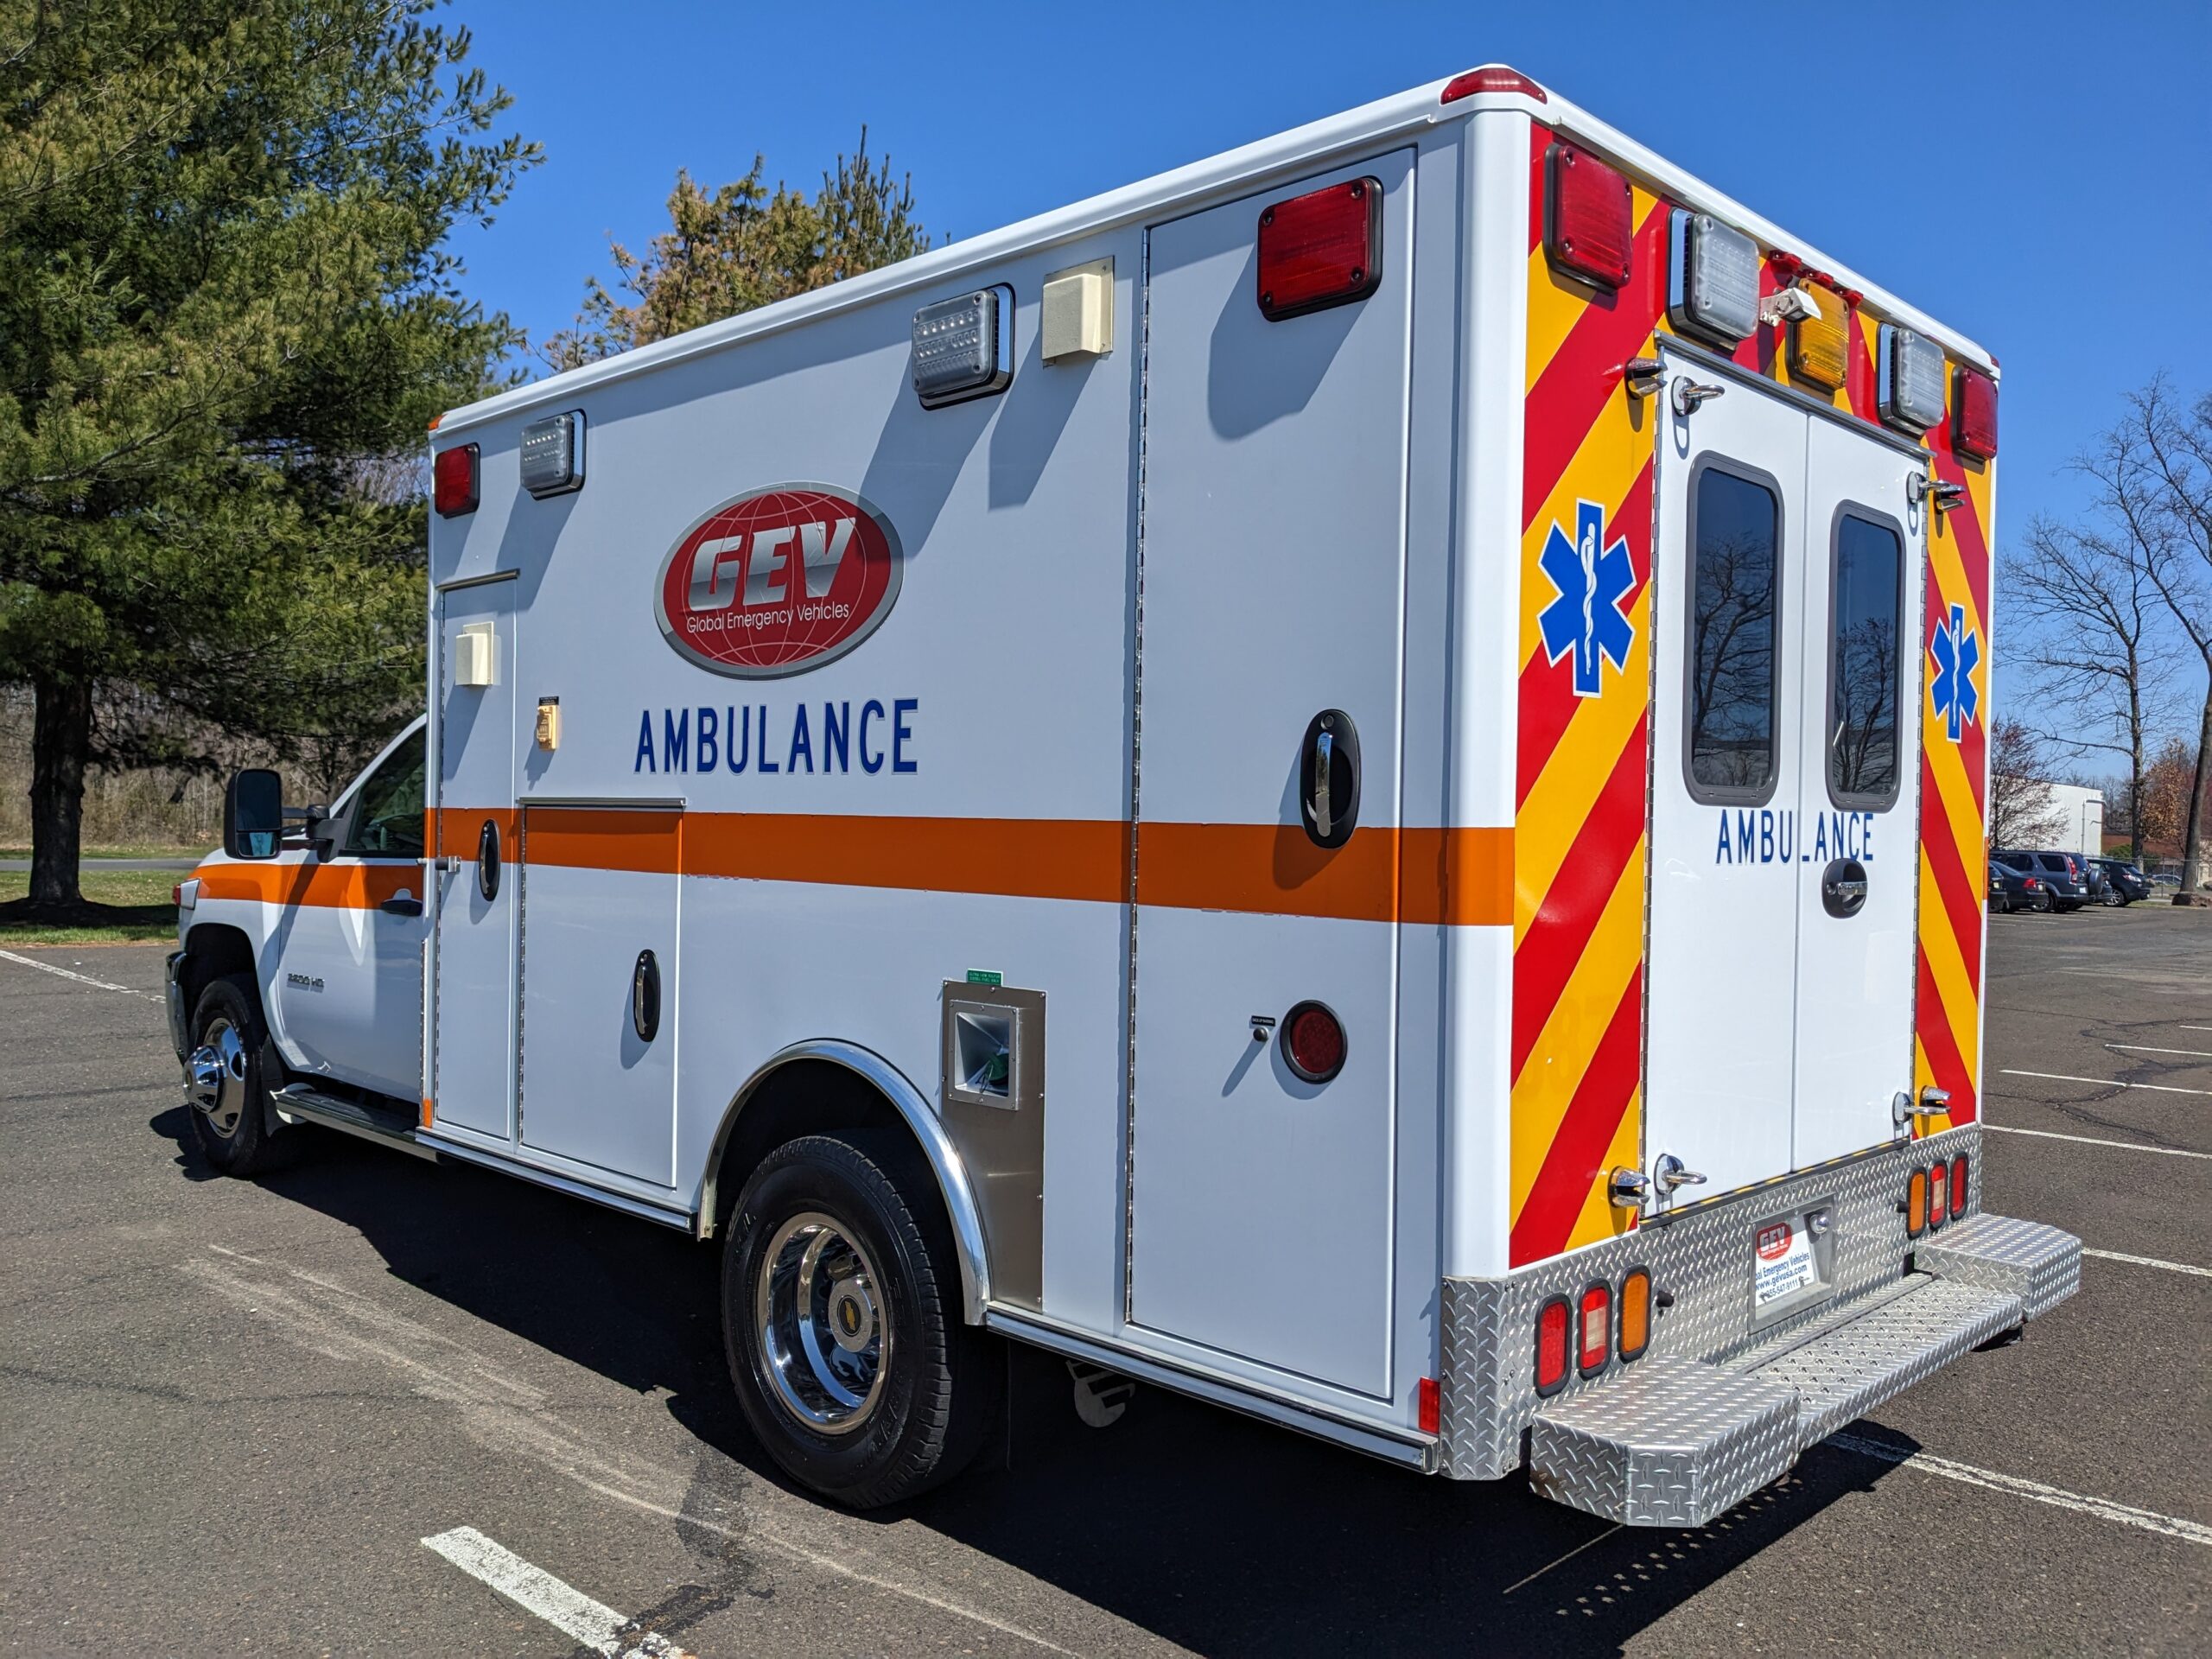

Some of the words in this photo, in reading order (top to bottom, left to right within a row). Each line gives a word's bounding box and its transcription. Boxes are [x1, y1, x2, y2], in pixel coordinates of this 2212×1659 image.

[688, 518, 857, 612] GEV
[686, 613, 724, 633] Global
[728, 608, 793, 630] Emergency
[797, 601, 849, 621] Vehicles
[633, 697, 918, 775] AMBULANCE
[1760, 1226, 1785, 1251] GEV
[1763, 1261, 1789, 1275] Emergency
[1789, 1252, 1810, 1266] Vehicles
